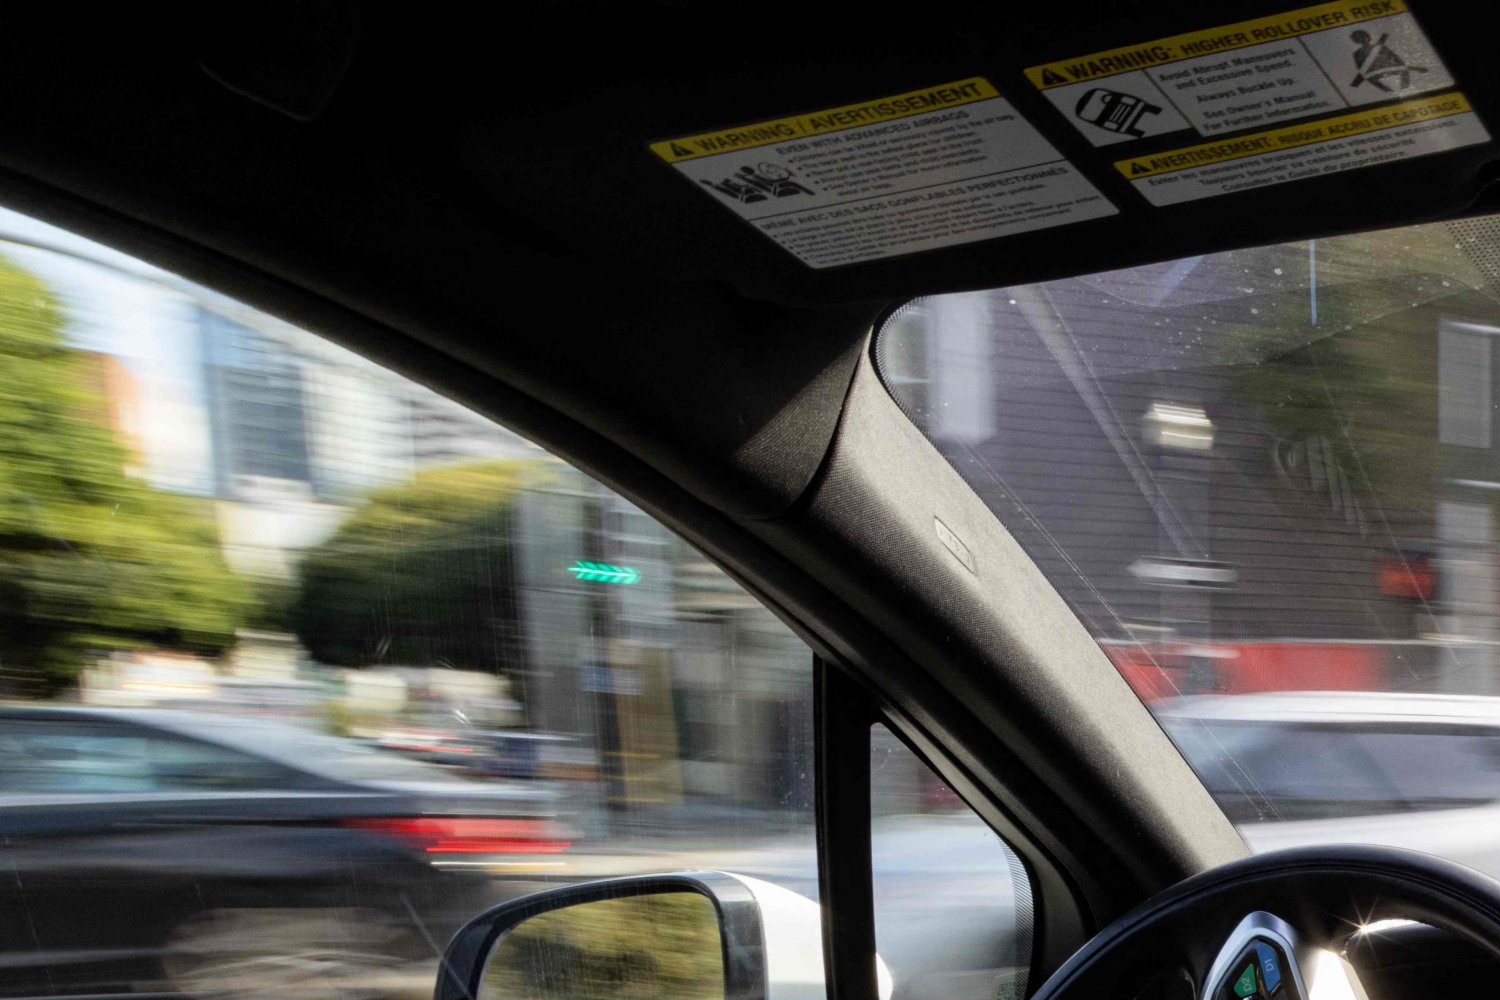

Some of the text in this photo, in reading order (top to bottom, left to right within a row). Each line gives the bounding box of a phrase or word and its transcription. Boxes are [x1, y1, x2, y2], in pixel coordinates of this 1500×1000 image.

[1067, 0, 1396, 78] WARNING: HIGHER ROLLOVER RISK
[1159, 48, 1294, 82] Avoid Abrupt Maneuvers
[1175, 79, 1196, 90] and
[1197, 69, 1252, 85] Excessive
[697, 124, 795, 150] WARNING
[811, 83, 979, 127] AVERTISSEMENT
[1151, 99, 1461, 169] AVERTISSEMENT: RISQUE ACCRU DE CAPOTAGE
